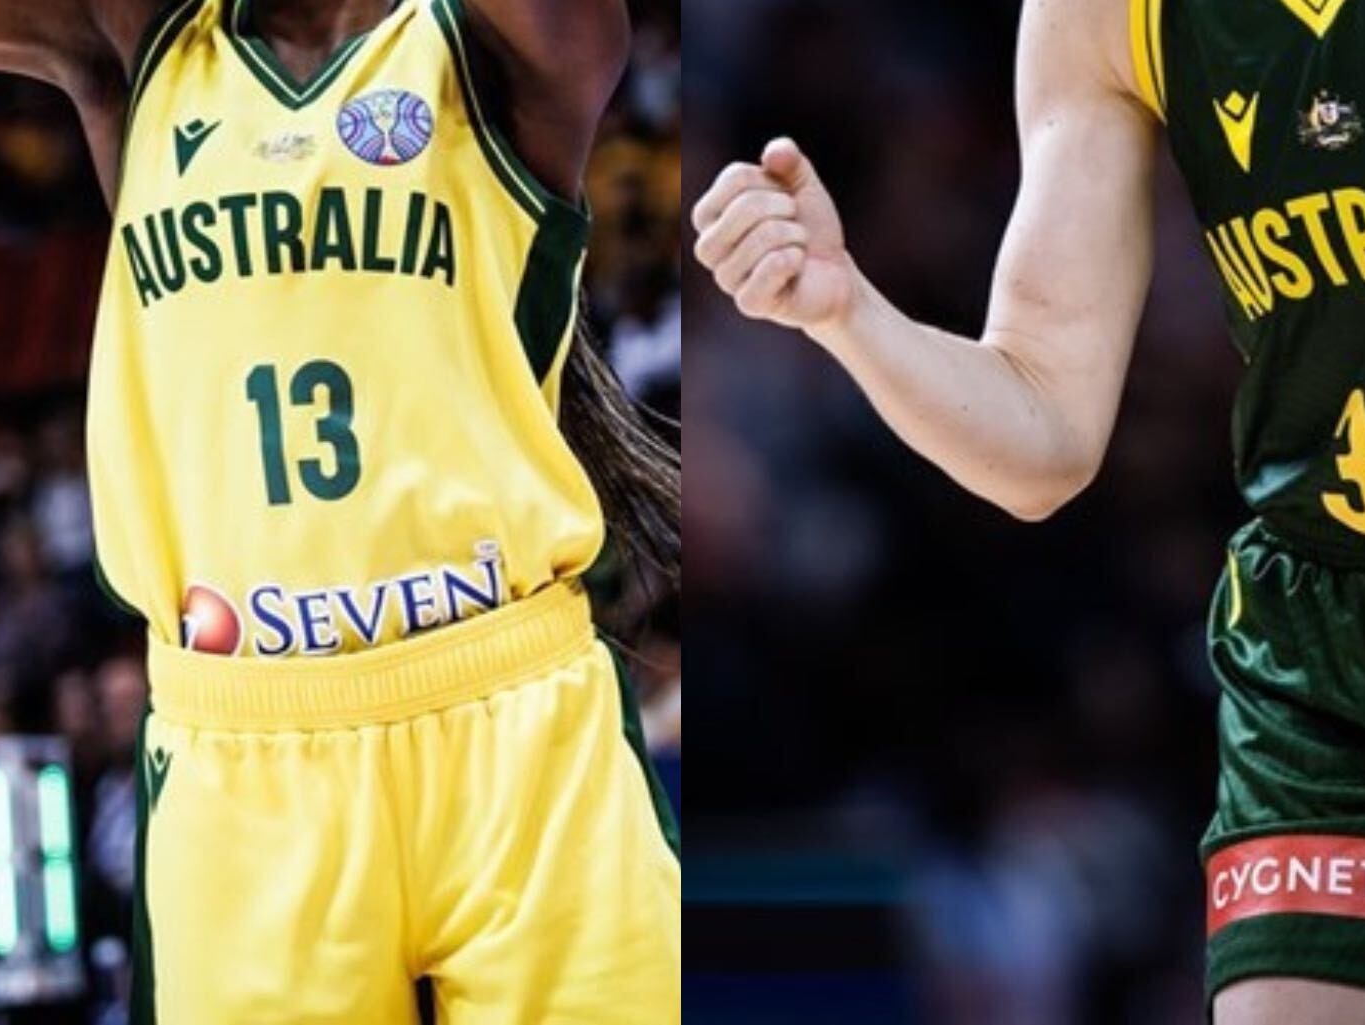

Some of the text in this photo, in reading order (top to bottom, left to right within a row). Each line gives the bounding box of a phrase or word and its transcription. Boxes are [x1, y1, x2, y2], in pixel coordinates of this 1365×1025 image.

[122, 186, 456, 307] AUSTRALIA
[245, 358, 362, 506] 13
[250, 558, 501, 656] SEVEN
